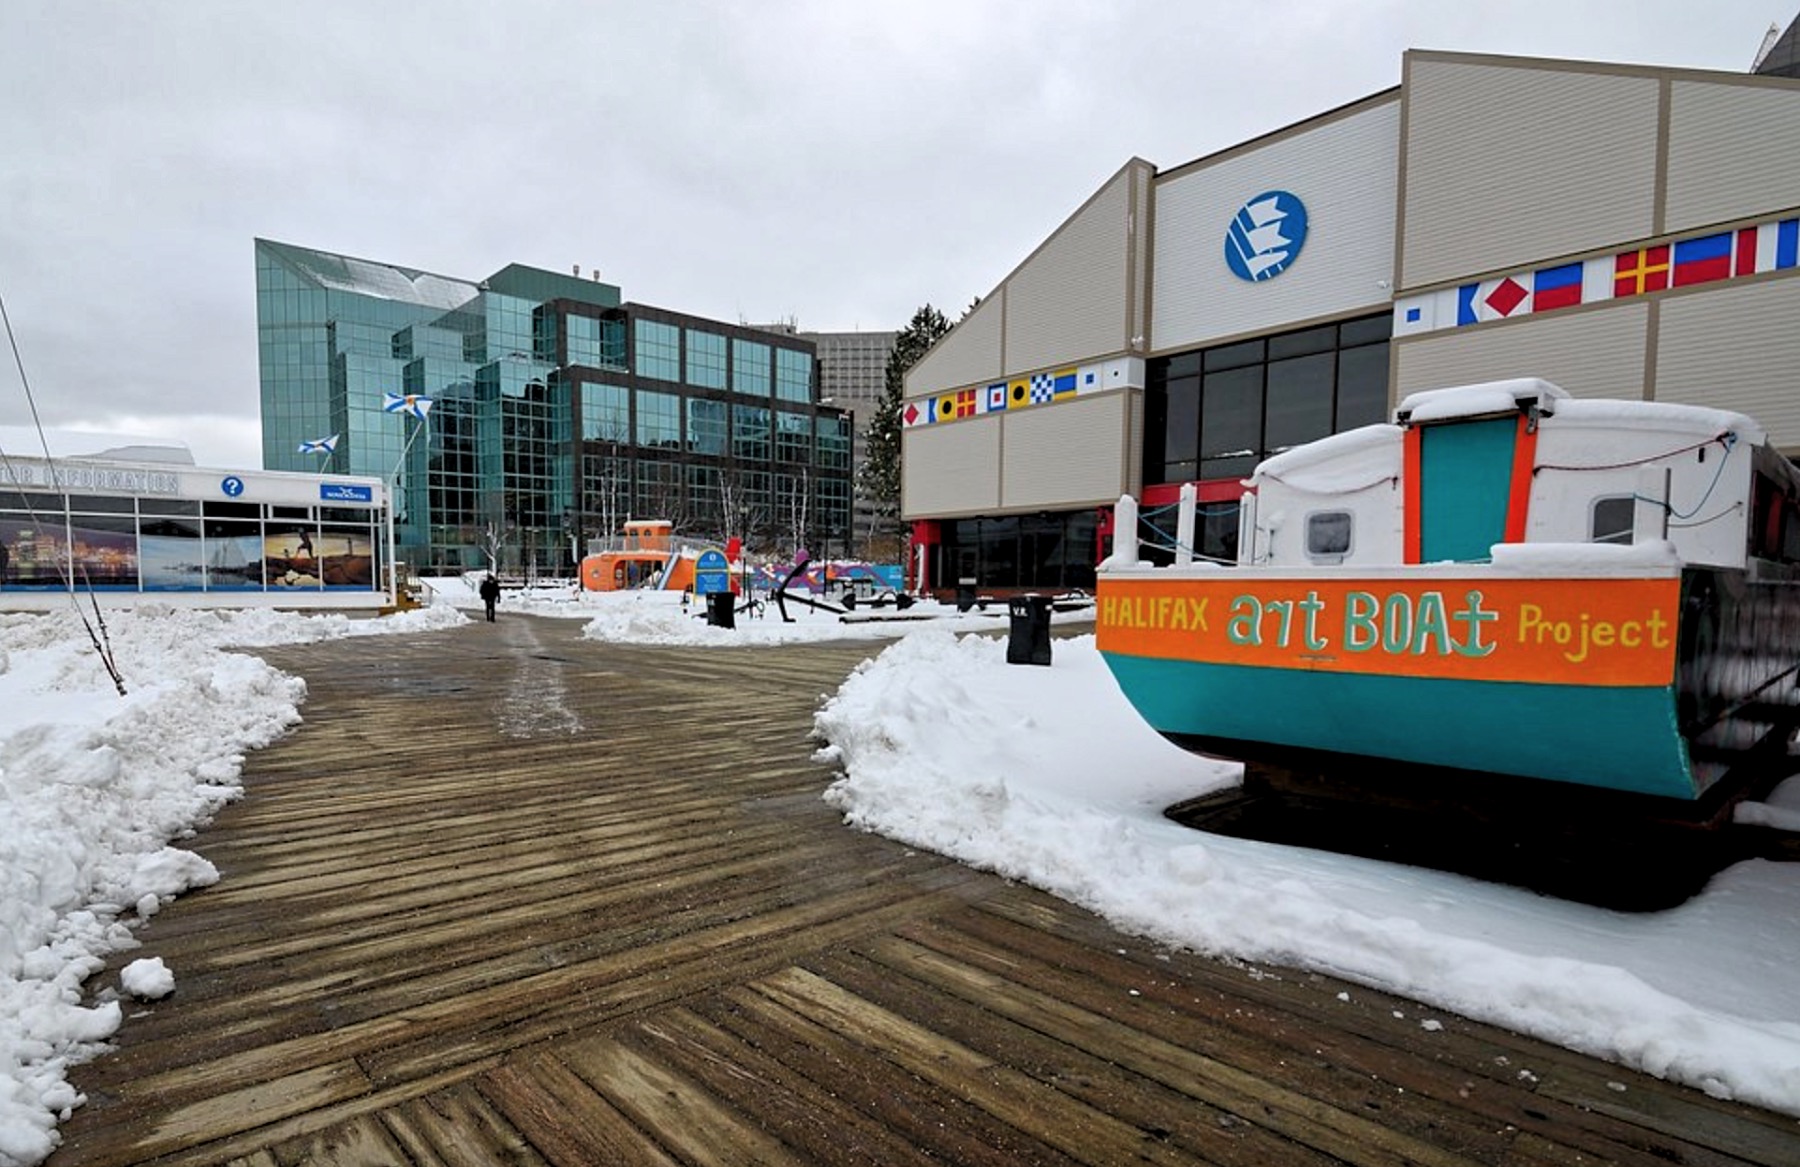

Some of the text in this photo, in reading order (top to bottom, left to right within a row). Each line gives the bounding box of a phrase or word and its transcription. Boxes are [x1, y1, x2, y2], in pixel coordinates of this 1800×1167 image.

[43, 467, 179, 492] INFORMATION
[1102, 596, 1209, 632] HALIFAX
[1226, 591, 1329, 650] art
[1518, 604, 1669, 662] Project
